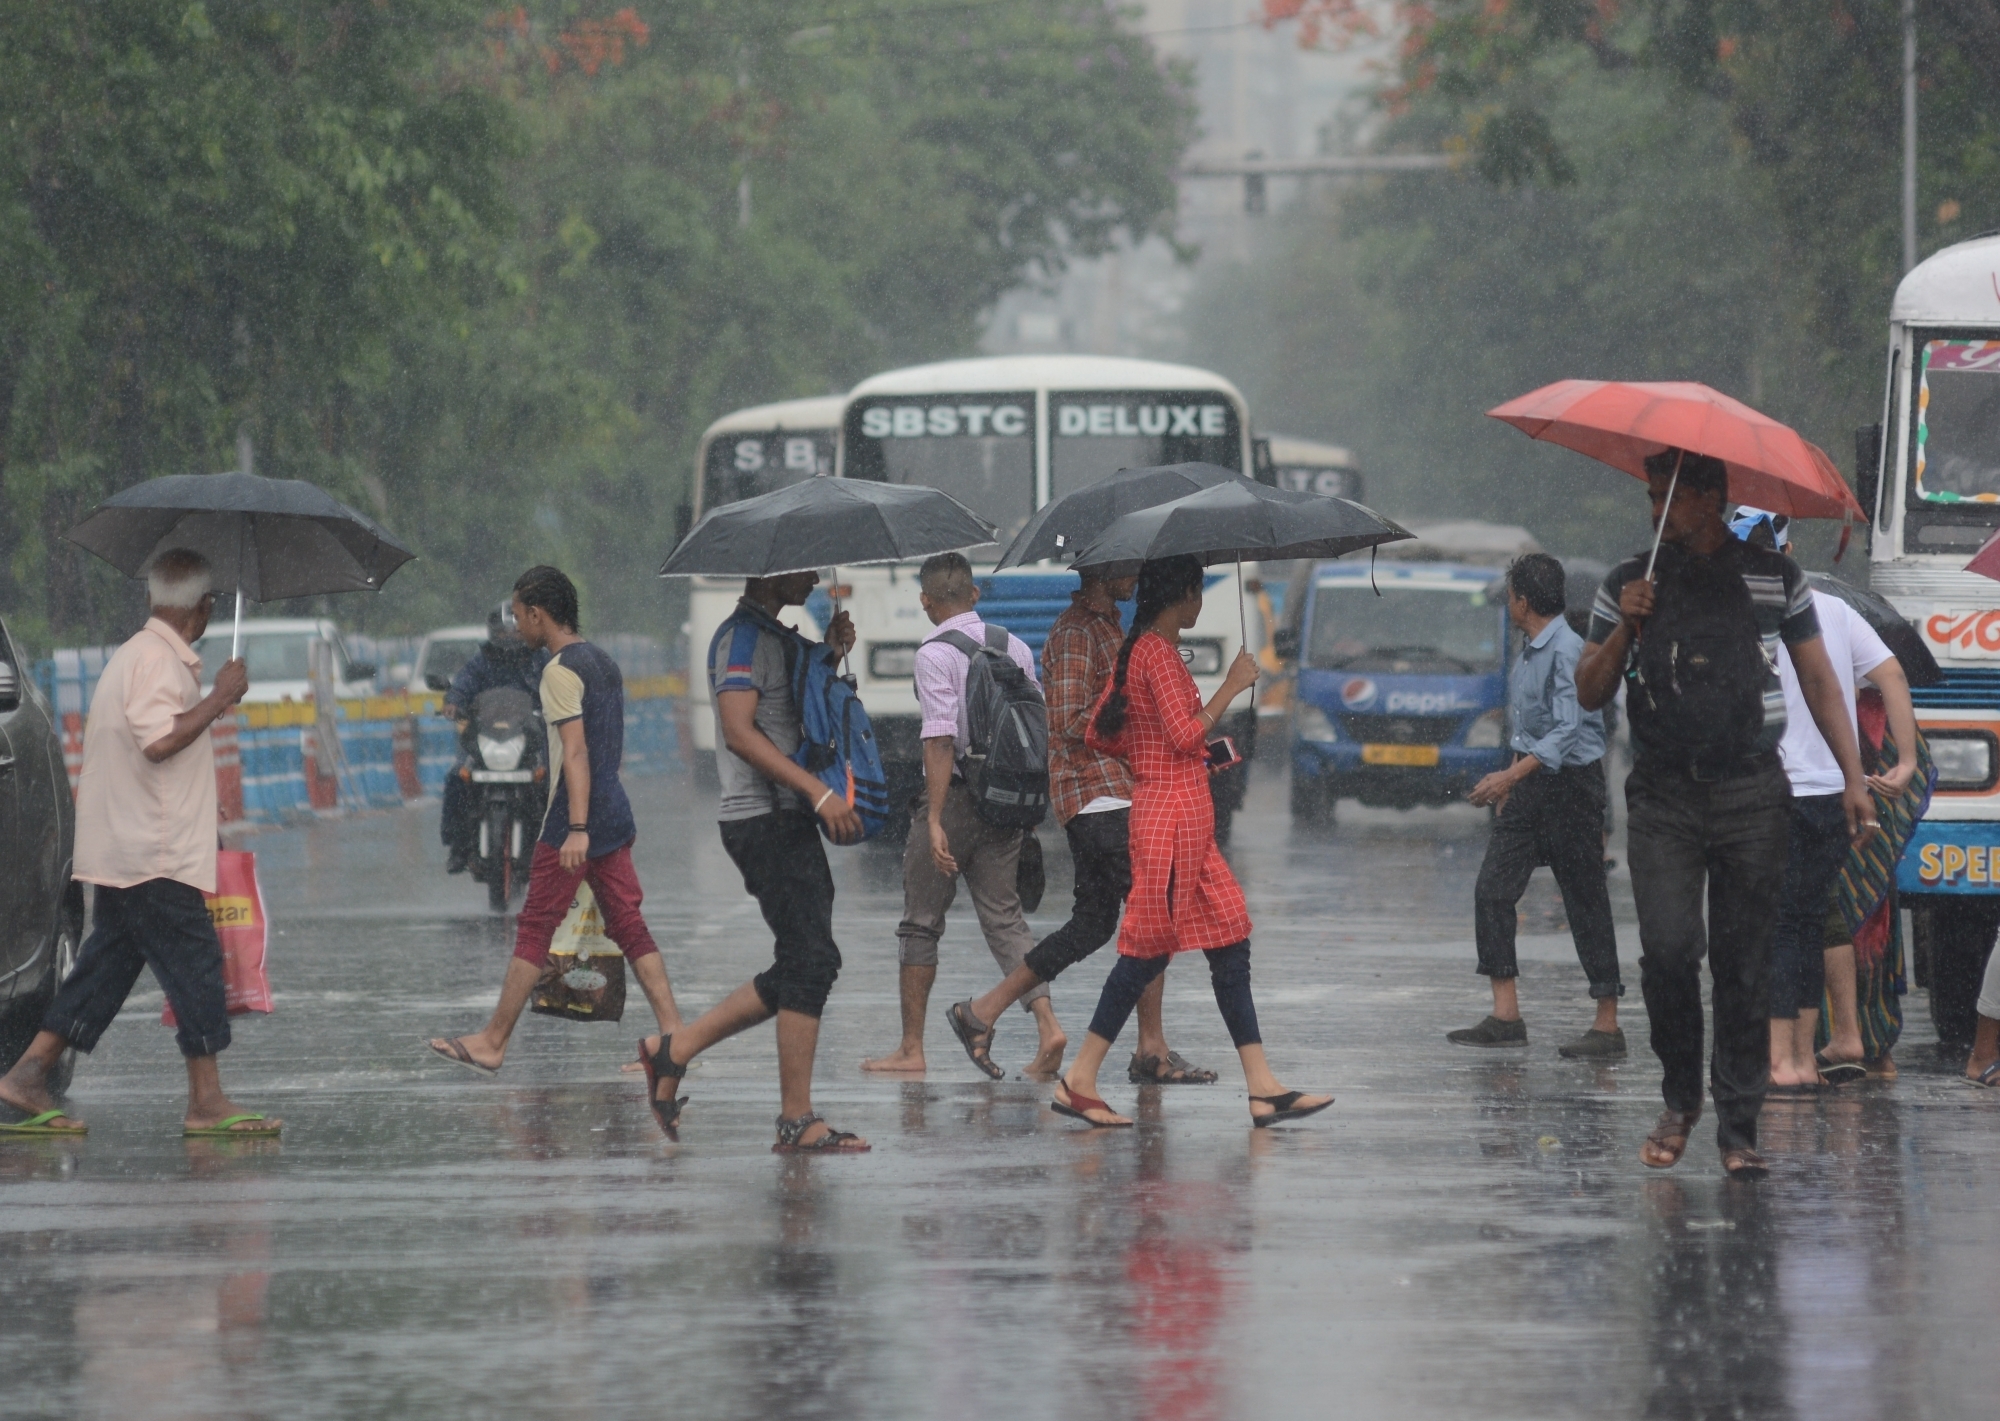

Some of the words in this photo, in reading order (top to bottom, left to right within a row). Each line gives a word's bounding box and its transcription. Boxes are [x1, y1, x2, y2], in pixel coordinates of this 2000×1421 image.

[862, 406, 1026, 437] SBSTC
[1058, 405, 1226, 436] DELUXE
[1387, 692, 1455, 714] pepsi
